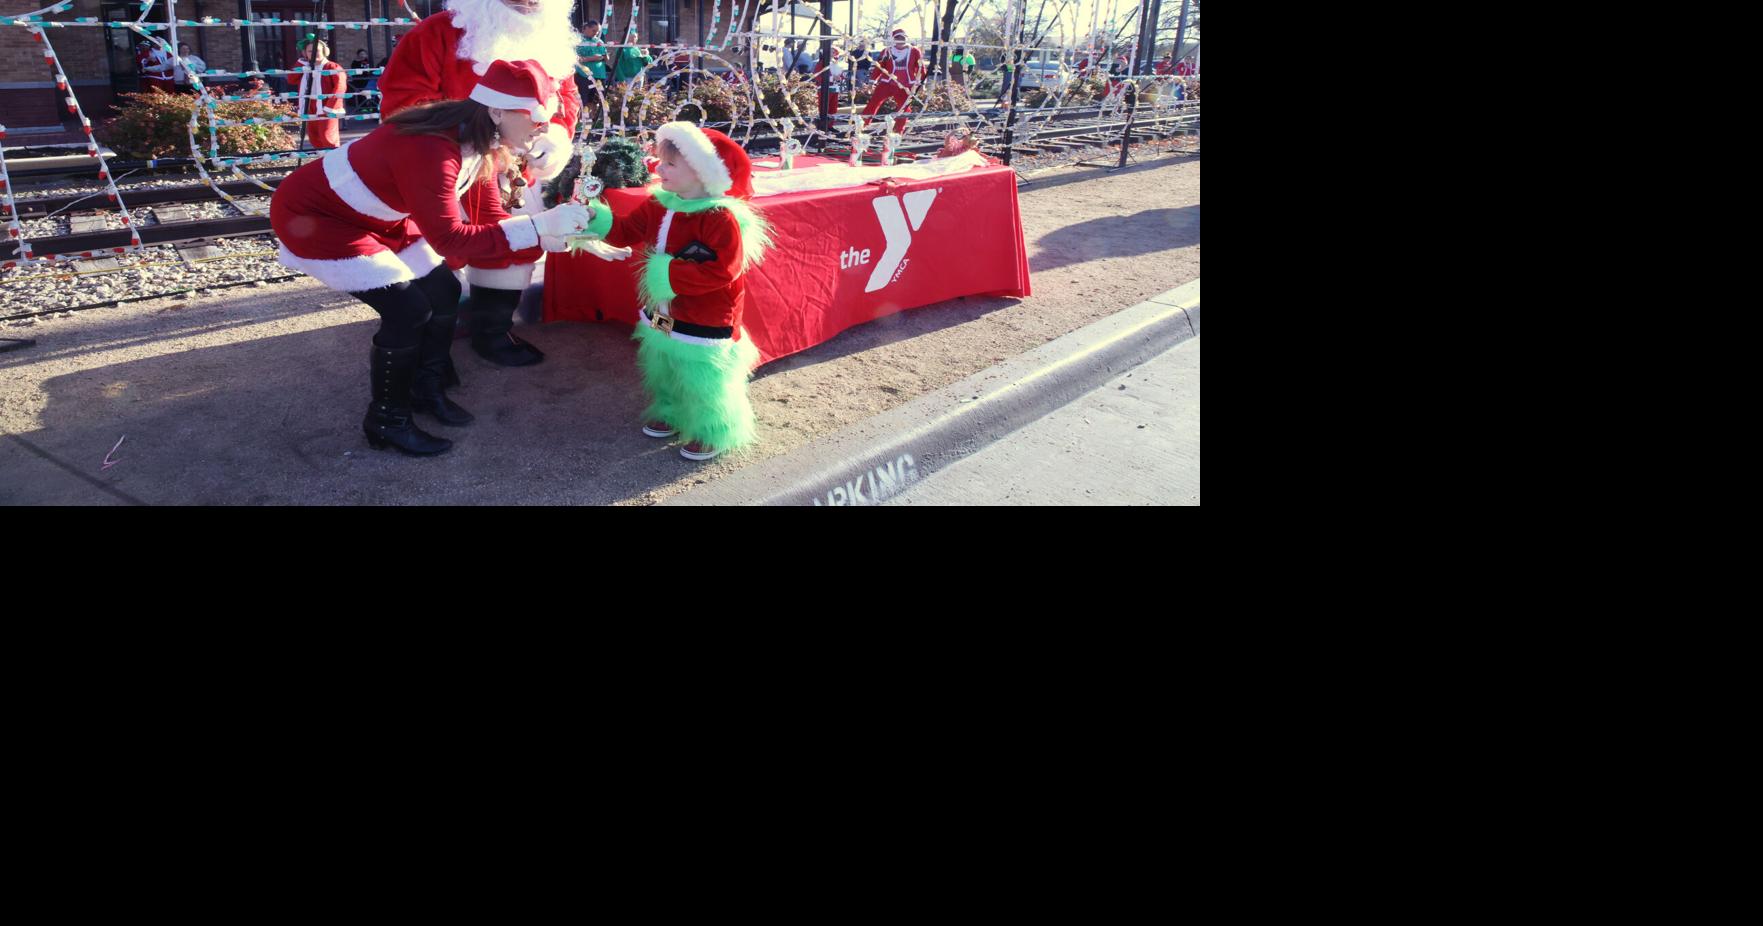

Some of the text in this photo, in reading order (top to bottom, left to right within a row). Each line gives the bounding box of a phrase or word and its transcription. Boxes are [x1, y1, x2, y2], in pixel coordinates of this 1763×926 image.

[840, 246, 870, 270] the
[891, 258, 910, 283] YMCA
[813, 454, 918, 506] RKING
